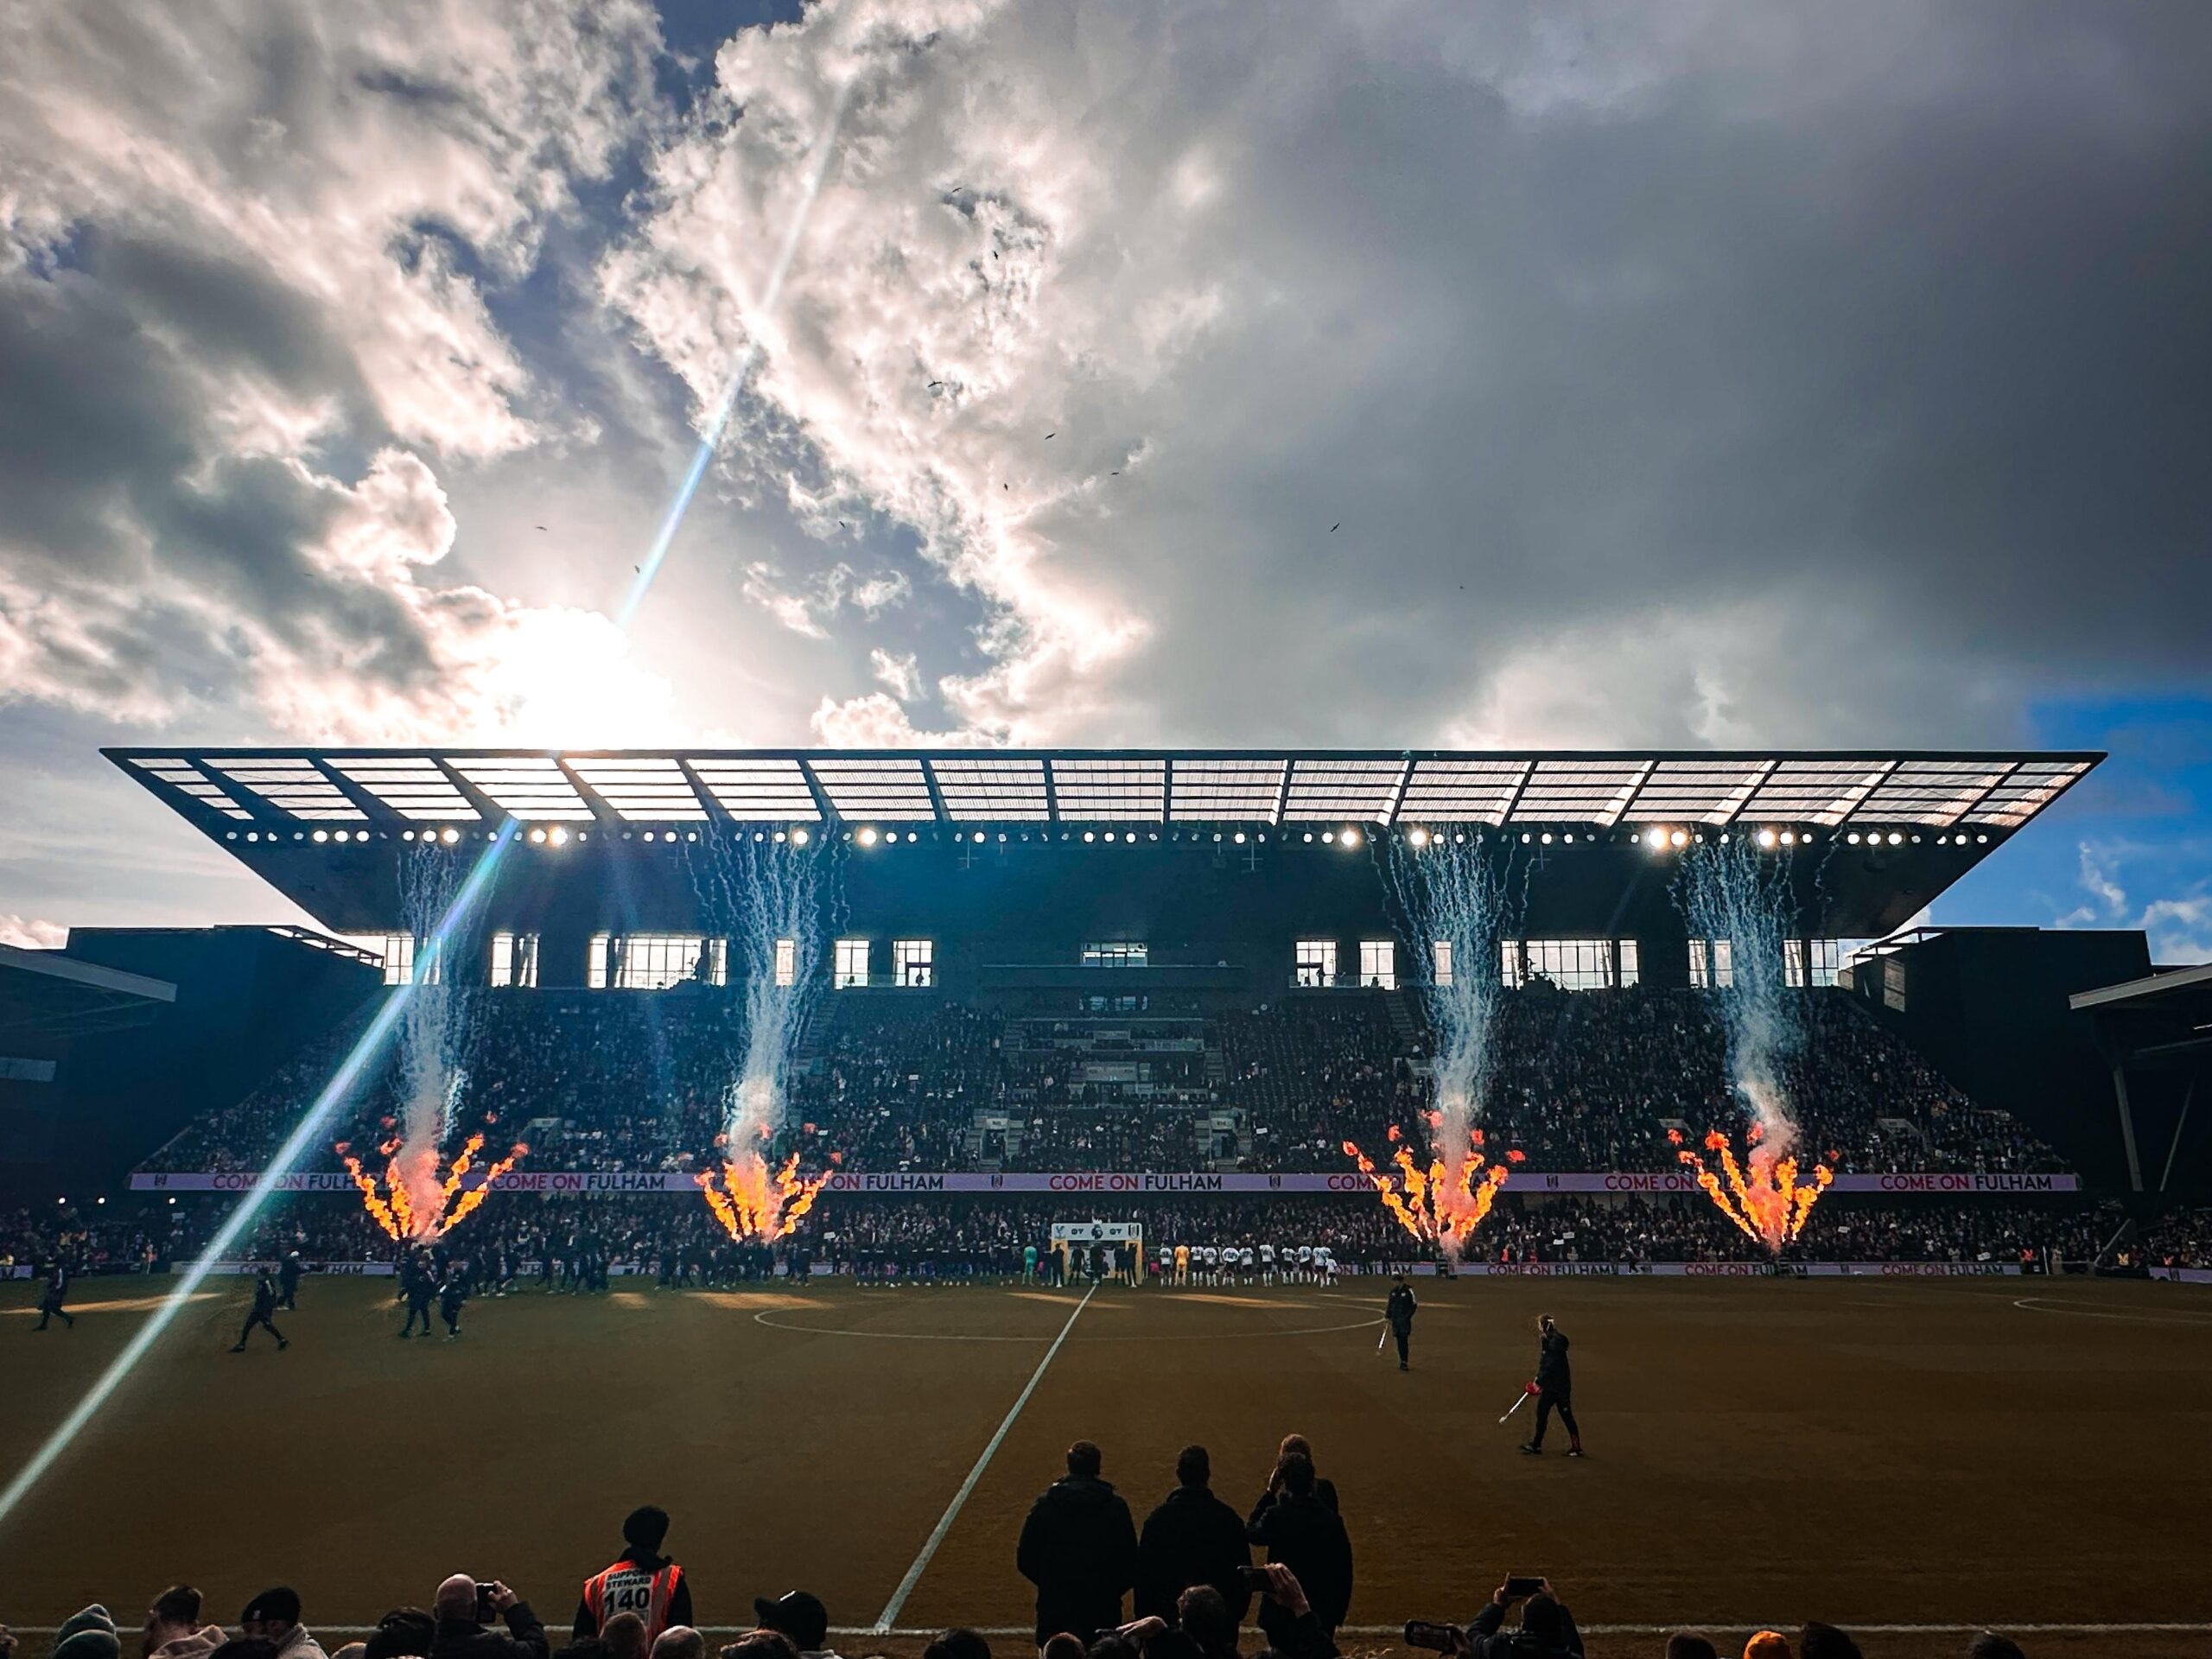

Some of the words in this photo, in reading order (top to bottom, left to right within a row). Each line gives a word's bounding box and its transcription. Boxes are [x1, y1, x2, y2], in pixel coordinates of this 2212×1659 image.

[213, 1174, 262, 1189] COM
[492, 1175, 547, 1190] COME
[552, 1175, 582, 1190] ON
[588, 1175, 665, 1190] FULHAM
[830, 1175, 861, 1190] ON
[867, 1175, 944, 1190] FULHAM
[1049, 1175, 1104, 1190] COME
[1109, 1175, 1139, 1190] ON
[1145, 1175, 1222, 1190] FULHAM
[1327, 1175, 1376, 1190] COM
[1605, 1175, 1659, 1190] COME
[1664, 1175, 1694, 1190] ON
[1880, 1175, 1935, 1190] COME
[1940, 1175, 1970, 1190] ON
[1975, 1175, 2052, 1190] FULHAM
[1487, 1265, 1529, 1276] COME
[1529, 1265, 1550, 1276] ON
[1685, 1265, 1724, 1276] COME
[1727, 1265, 1748, 1276] ON
[1882, 1265, 1920, 1276] COME
[1924, 1265, 1946, 1276] ON
[1949, 1265, 2004, 1276] FULHAM
[605, 1587, 650, 1612] 140
